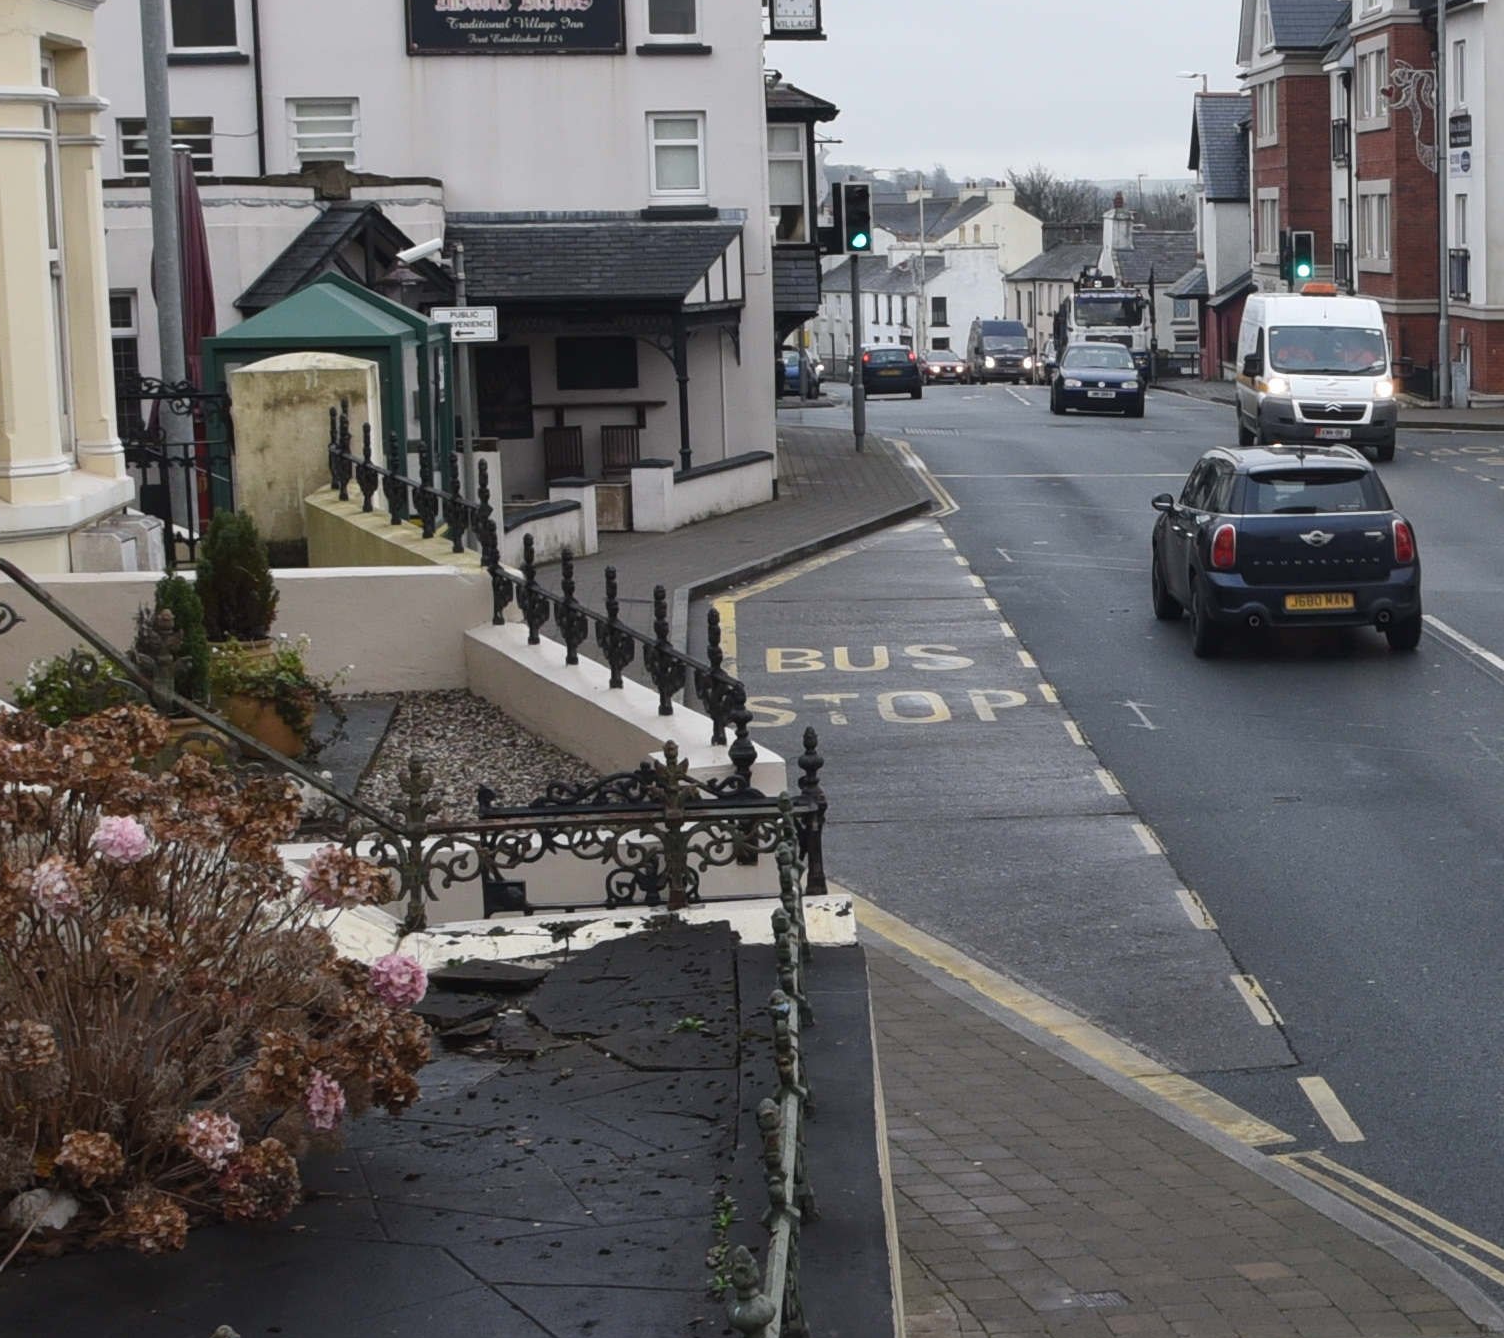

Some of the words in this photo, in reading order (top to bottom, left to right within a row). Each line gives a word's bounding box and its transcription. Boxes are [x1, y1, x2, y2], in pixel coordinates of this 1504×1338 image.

[446, 16, 509, 29] Traditional
[514, 16, 557, 31] Village
[561, 16, 584, 29] Inn
[766, 644, 975, 673] BUS
[744, 690, 1028, 728] STOP
